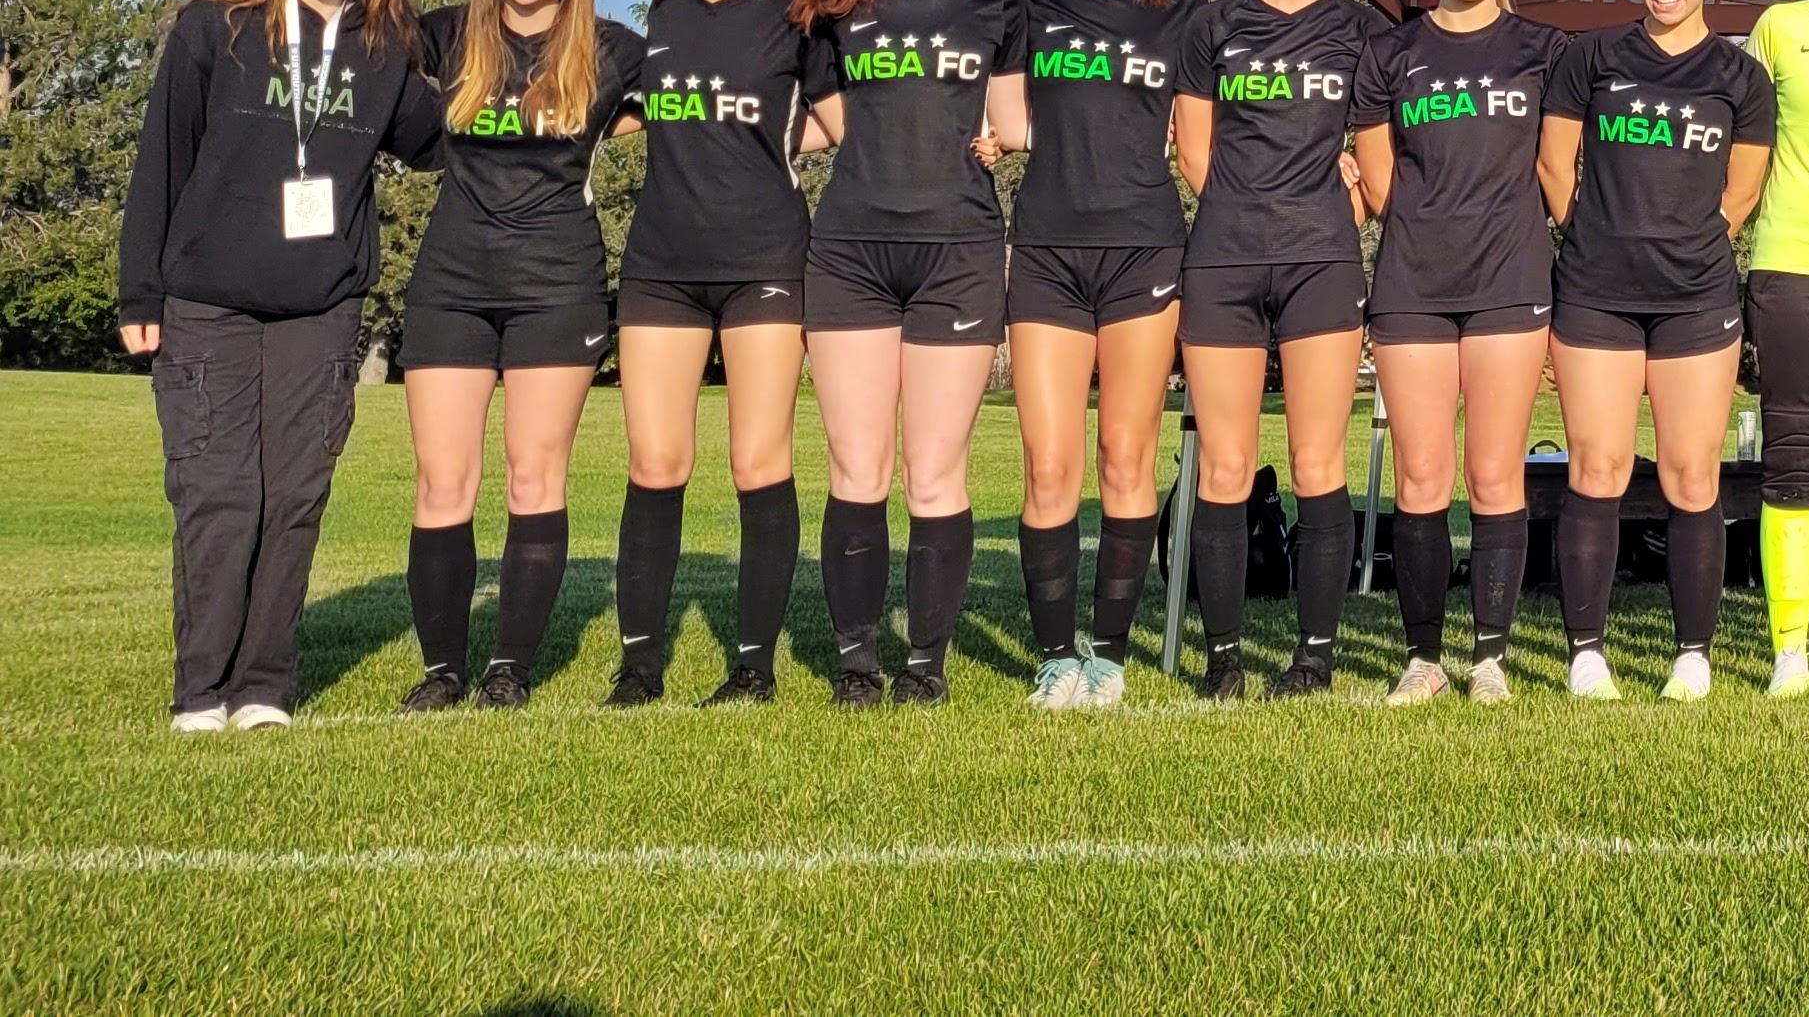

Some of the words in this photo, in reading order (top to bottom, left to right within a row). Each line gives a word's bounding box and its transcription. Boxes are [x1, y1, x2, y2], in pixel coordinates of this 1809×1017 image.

[844, 51, 925, 81] MSA
[936, 51, 982, 80] FC
[1033, 51, 1112, 81] MSA
[1122, 57, 1166, 88] FC
[265, 77, 354, 118] MSA
[1219, 74, 1293, 101] MSA
[1303, 74, 1343, 100] FC
[450, 109, 523, 135] SA
[716, 95, 760, 124] FC
[1402, 92, 1478, 128] MSA
[1487, 90, 1527, 117] FC
[1598, 114, 1673, 147] MSA
[1682, 123, 1723, 153] FC
